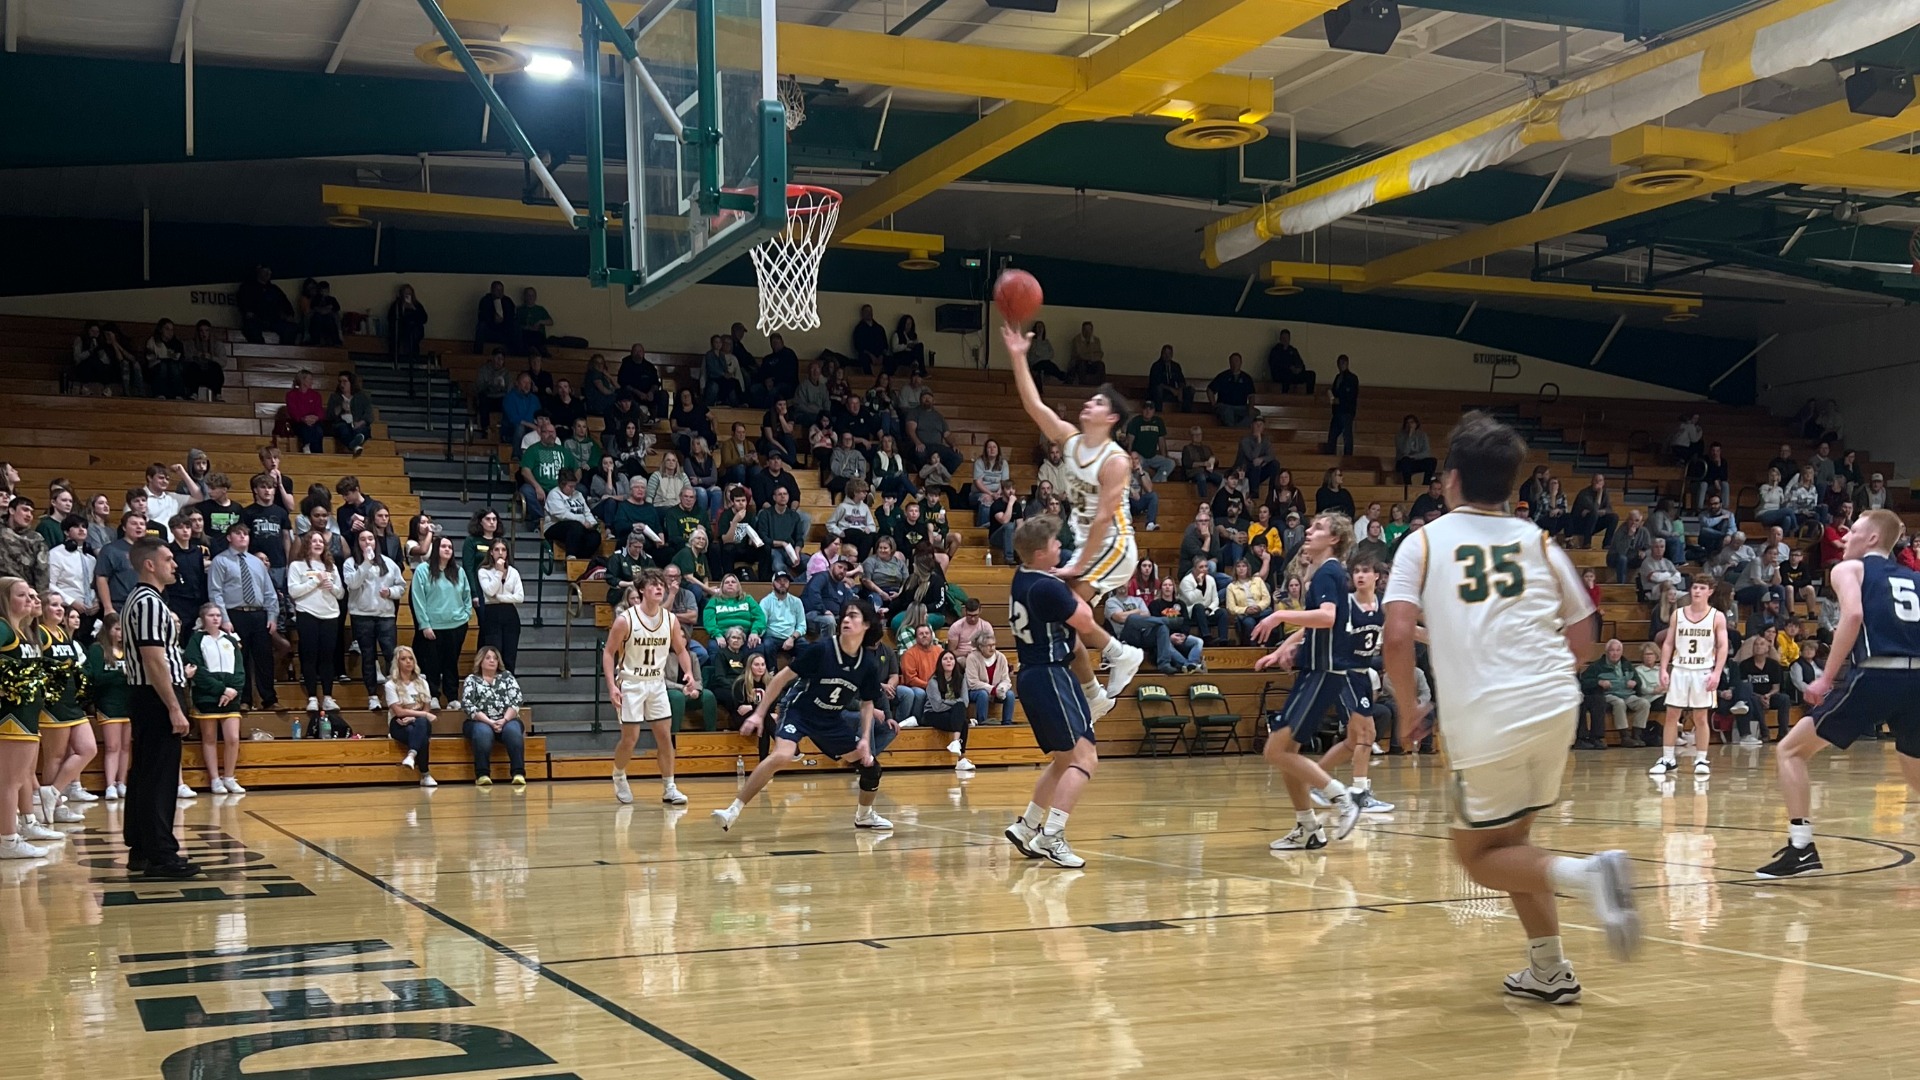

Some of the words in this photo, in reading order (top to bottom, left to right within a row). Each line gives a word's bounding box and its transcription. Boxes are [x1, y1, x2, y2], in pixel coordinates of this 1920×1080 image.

[1455, 542, 1525, 603] 35
[1888, 575, 1920, 622] 5
[715, 602, 750, 614] EAGLES
[1678, 628, 1711, 637] MADISON
[633, 637, 668, 646] MADISON
[1364, 632, 1374, 649] 3
[1689, 639, 1697, 654] 3
[643, 648, 656, 666] 11
[829, 686, 842, 703] 4
[1141, 686, 1167, 697] EAGLES
[1193, 684, 1219, 695] EAGLES
